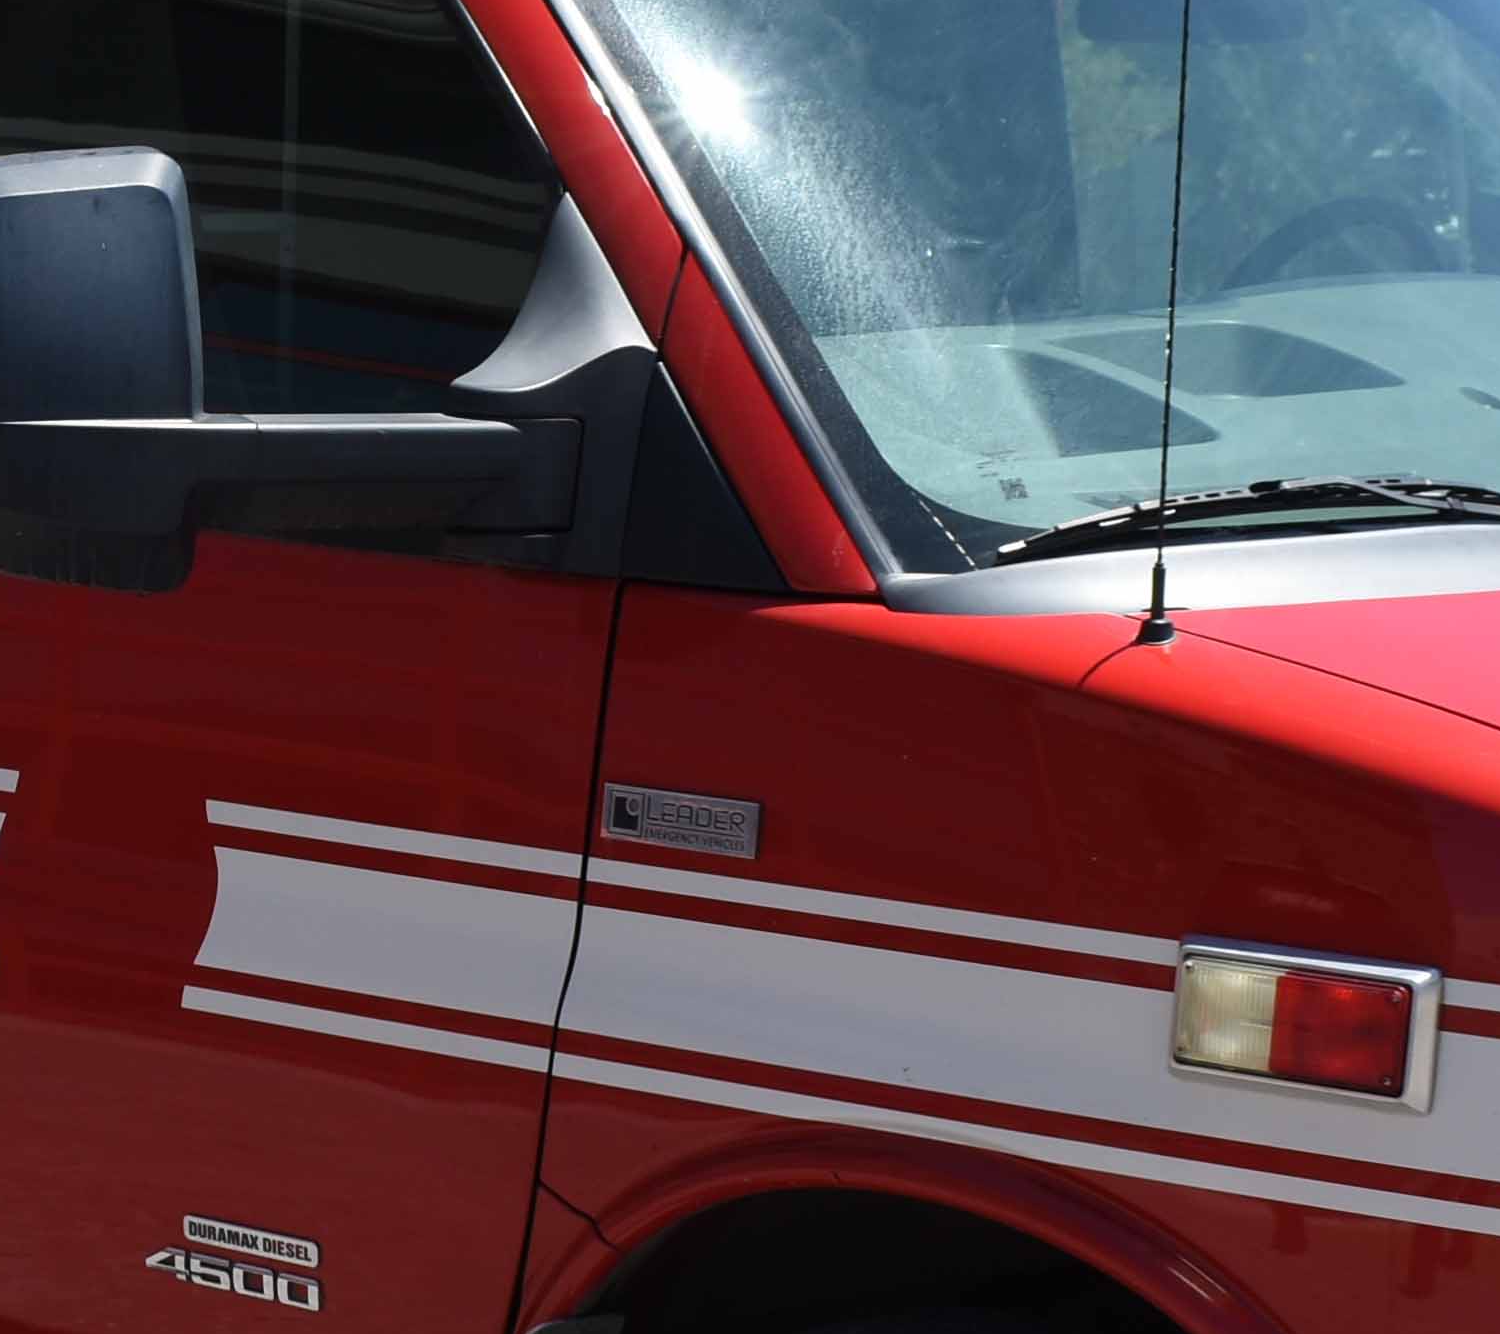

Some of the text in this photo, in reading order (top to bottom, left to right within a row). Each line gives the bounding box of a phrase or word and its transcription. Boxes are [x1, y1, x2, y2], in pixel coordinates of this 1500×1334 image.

[647, 794, 745, 834] LEADER
[188, 1220, 312, 1262] DURAMAX DIESEL
[145, 1246, 320, 1311] 4500
